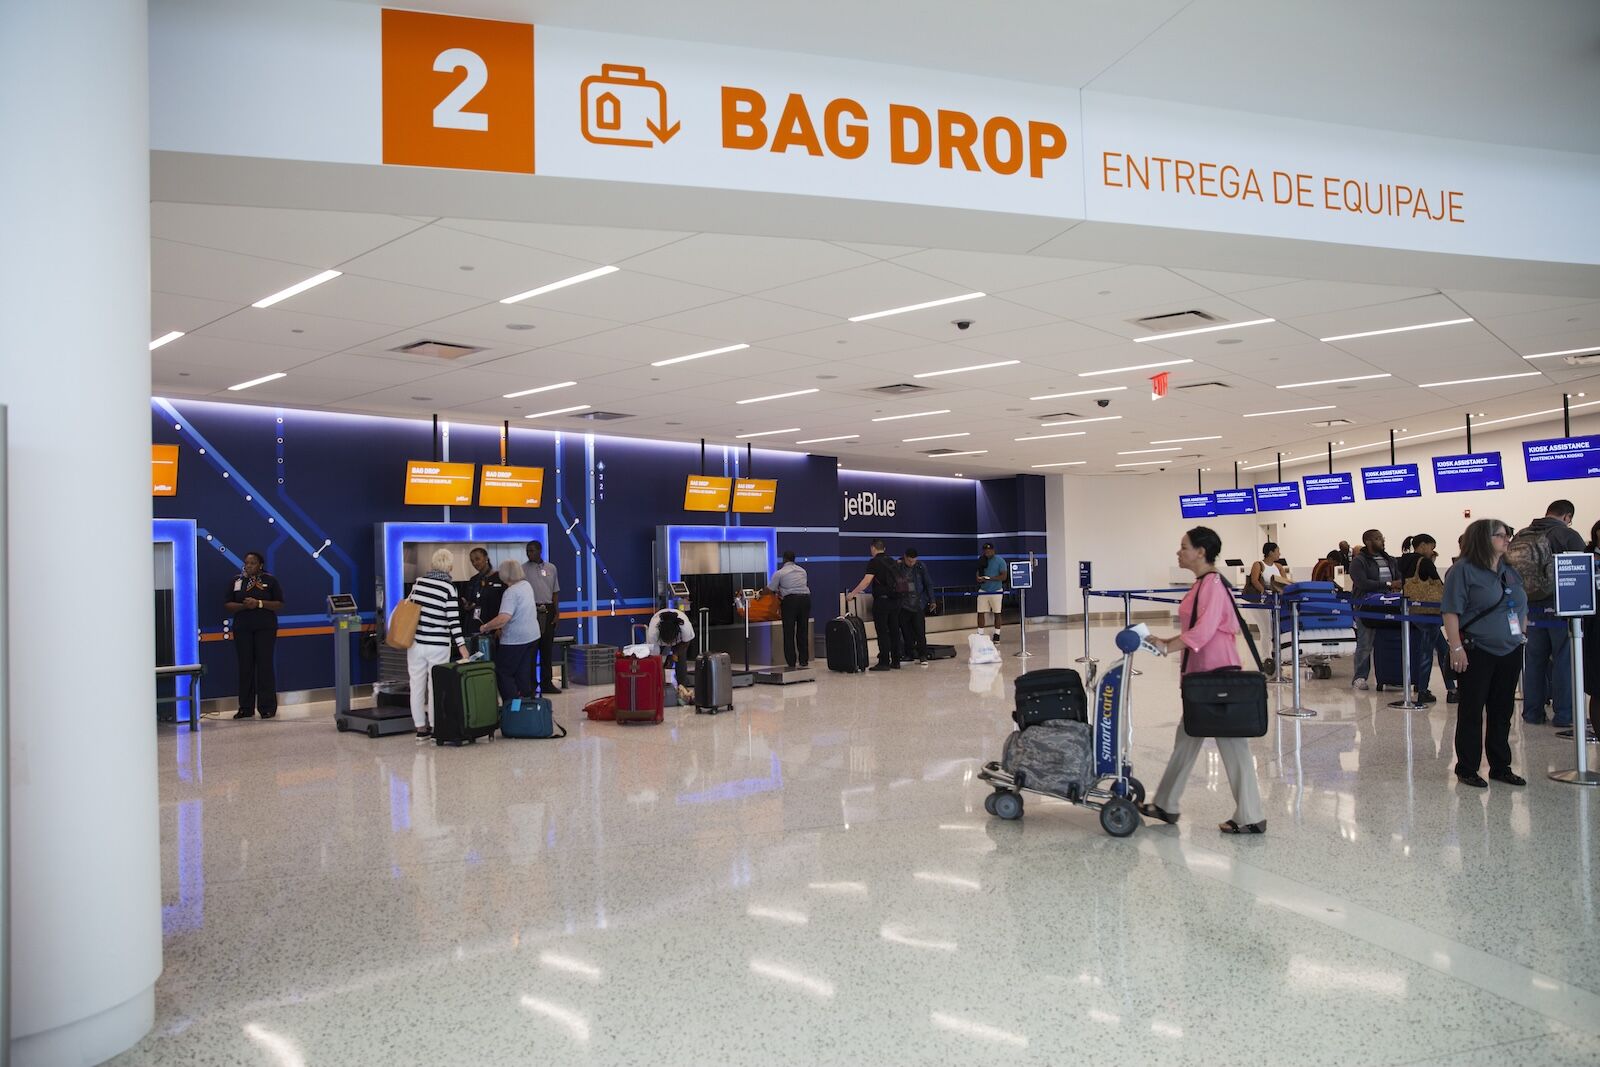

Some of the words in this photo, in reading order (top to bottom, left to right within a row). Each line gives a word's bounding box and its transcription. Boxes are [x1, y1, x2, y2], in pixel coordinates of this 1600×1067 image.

[432, 47, 489, 132] 2
[720, 85, 870, 160] BAG
[889, 103, 1067, 179] DROP
[1103, 151, 1264, 202] ENTREGA
[1273, 171, 1314, 208] DE
[1324, 177, 1465, 223] EQUIPAJE
[1549, 442, 1590, 452] ASSISTANCE
[843, 490, 896, 521] jetBlue
[1100, 685, 1113, 762] smartecarte
